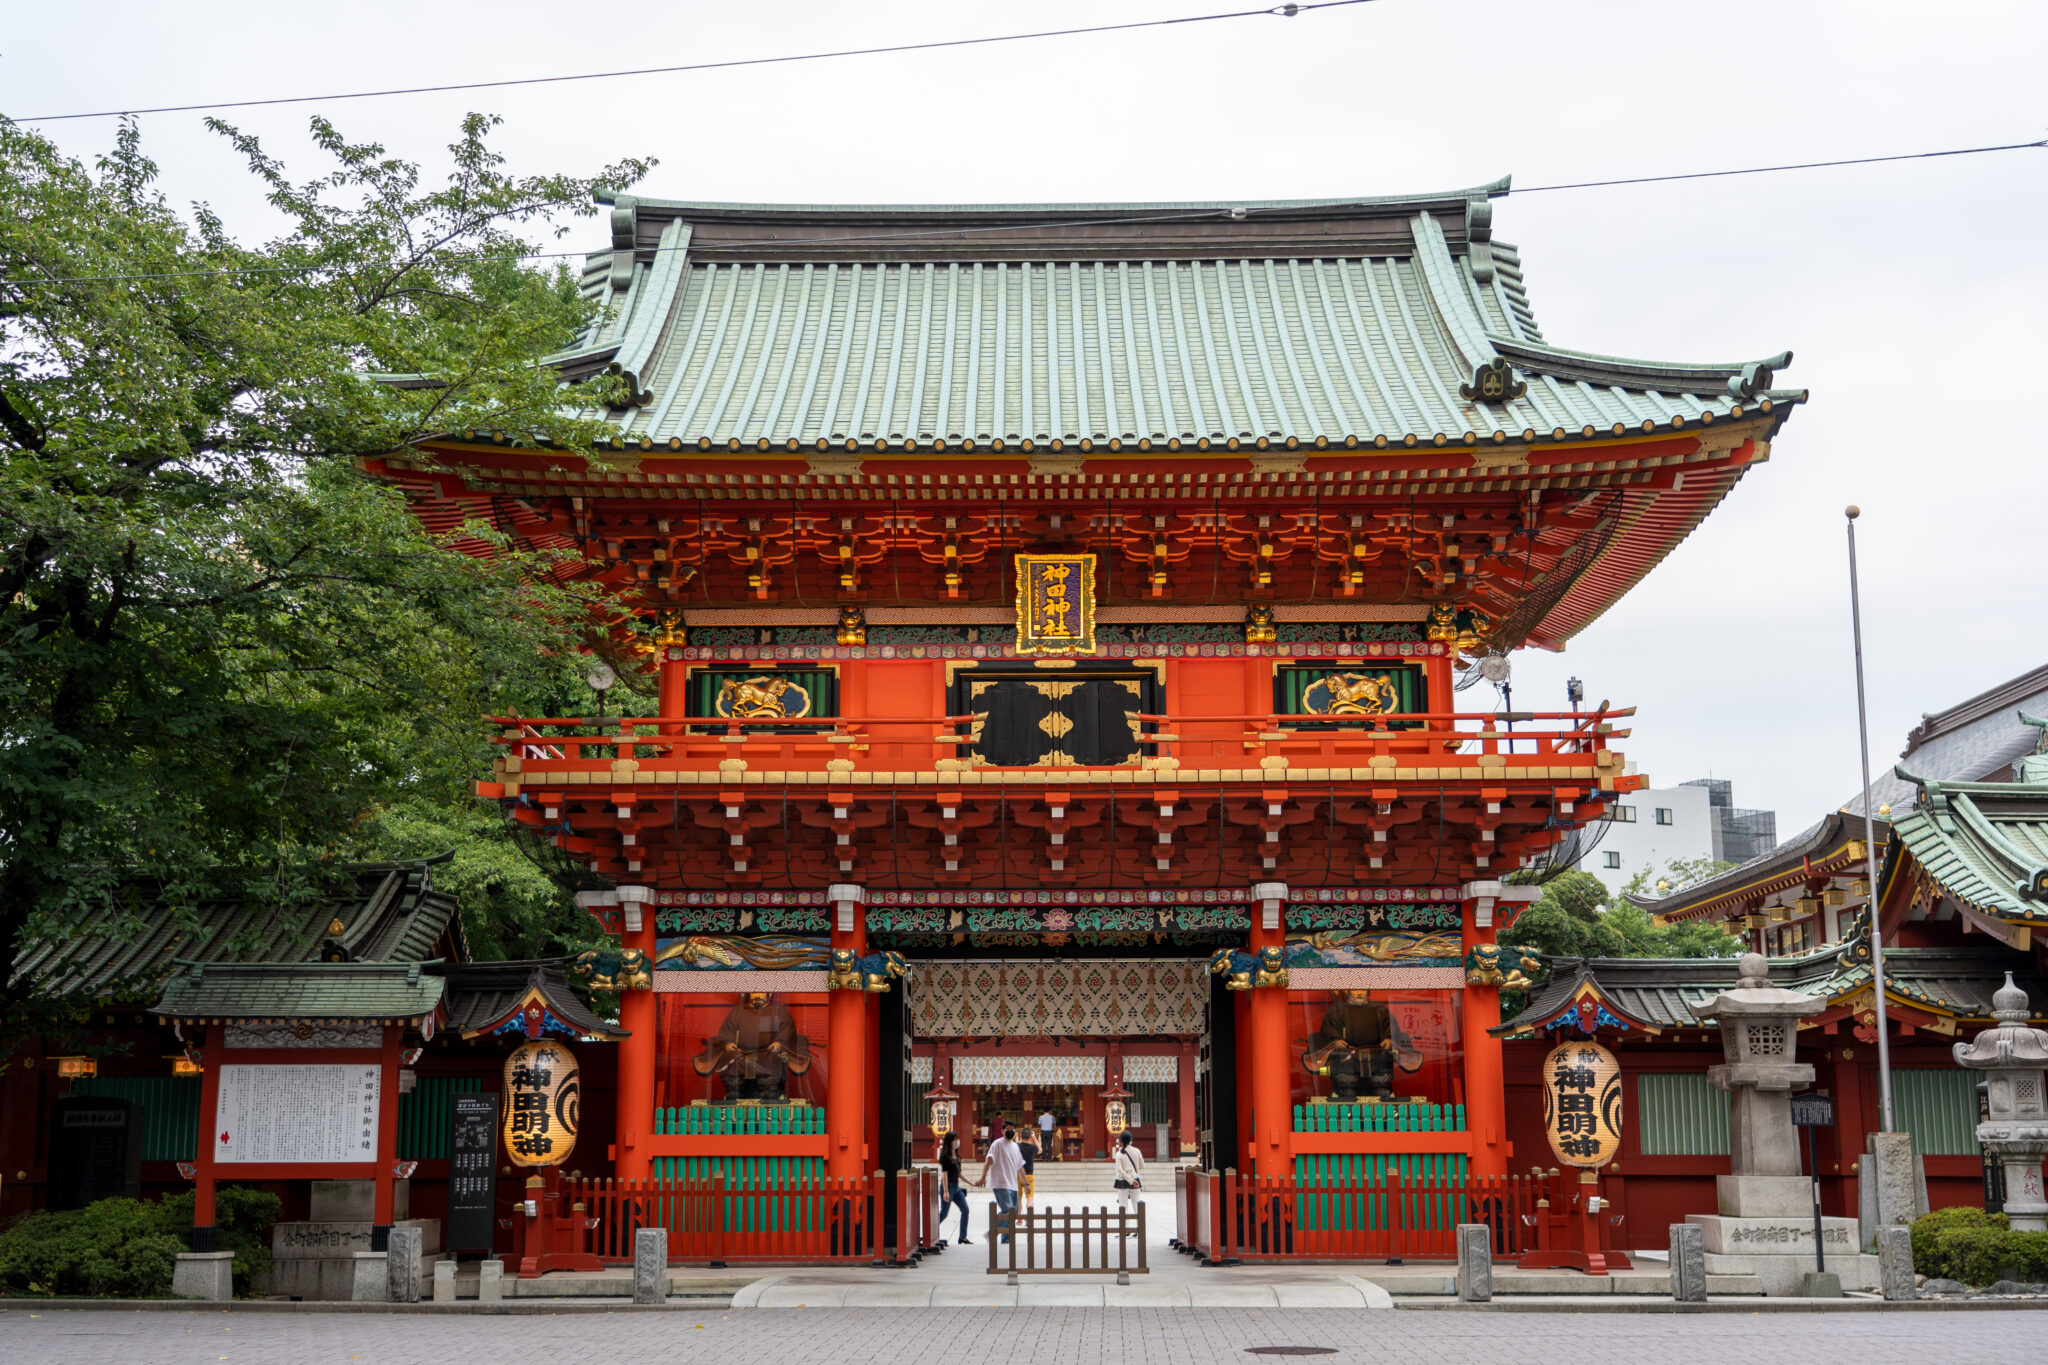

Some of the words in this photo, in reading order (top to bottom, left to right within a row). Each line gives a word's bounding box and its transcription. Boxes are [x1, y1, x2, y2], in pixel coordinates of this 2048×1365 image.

[1041, 563, 1071, 636] 神田神社
[361, 1068, 375, 1150] 神田神社御由緒
[511, 1064, 554, 1157] 神田明神
[1553, 1065, 1602, 1157] 神田明神
[2024, 1165, 2039, 1196] 奉献
